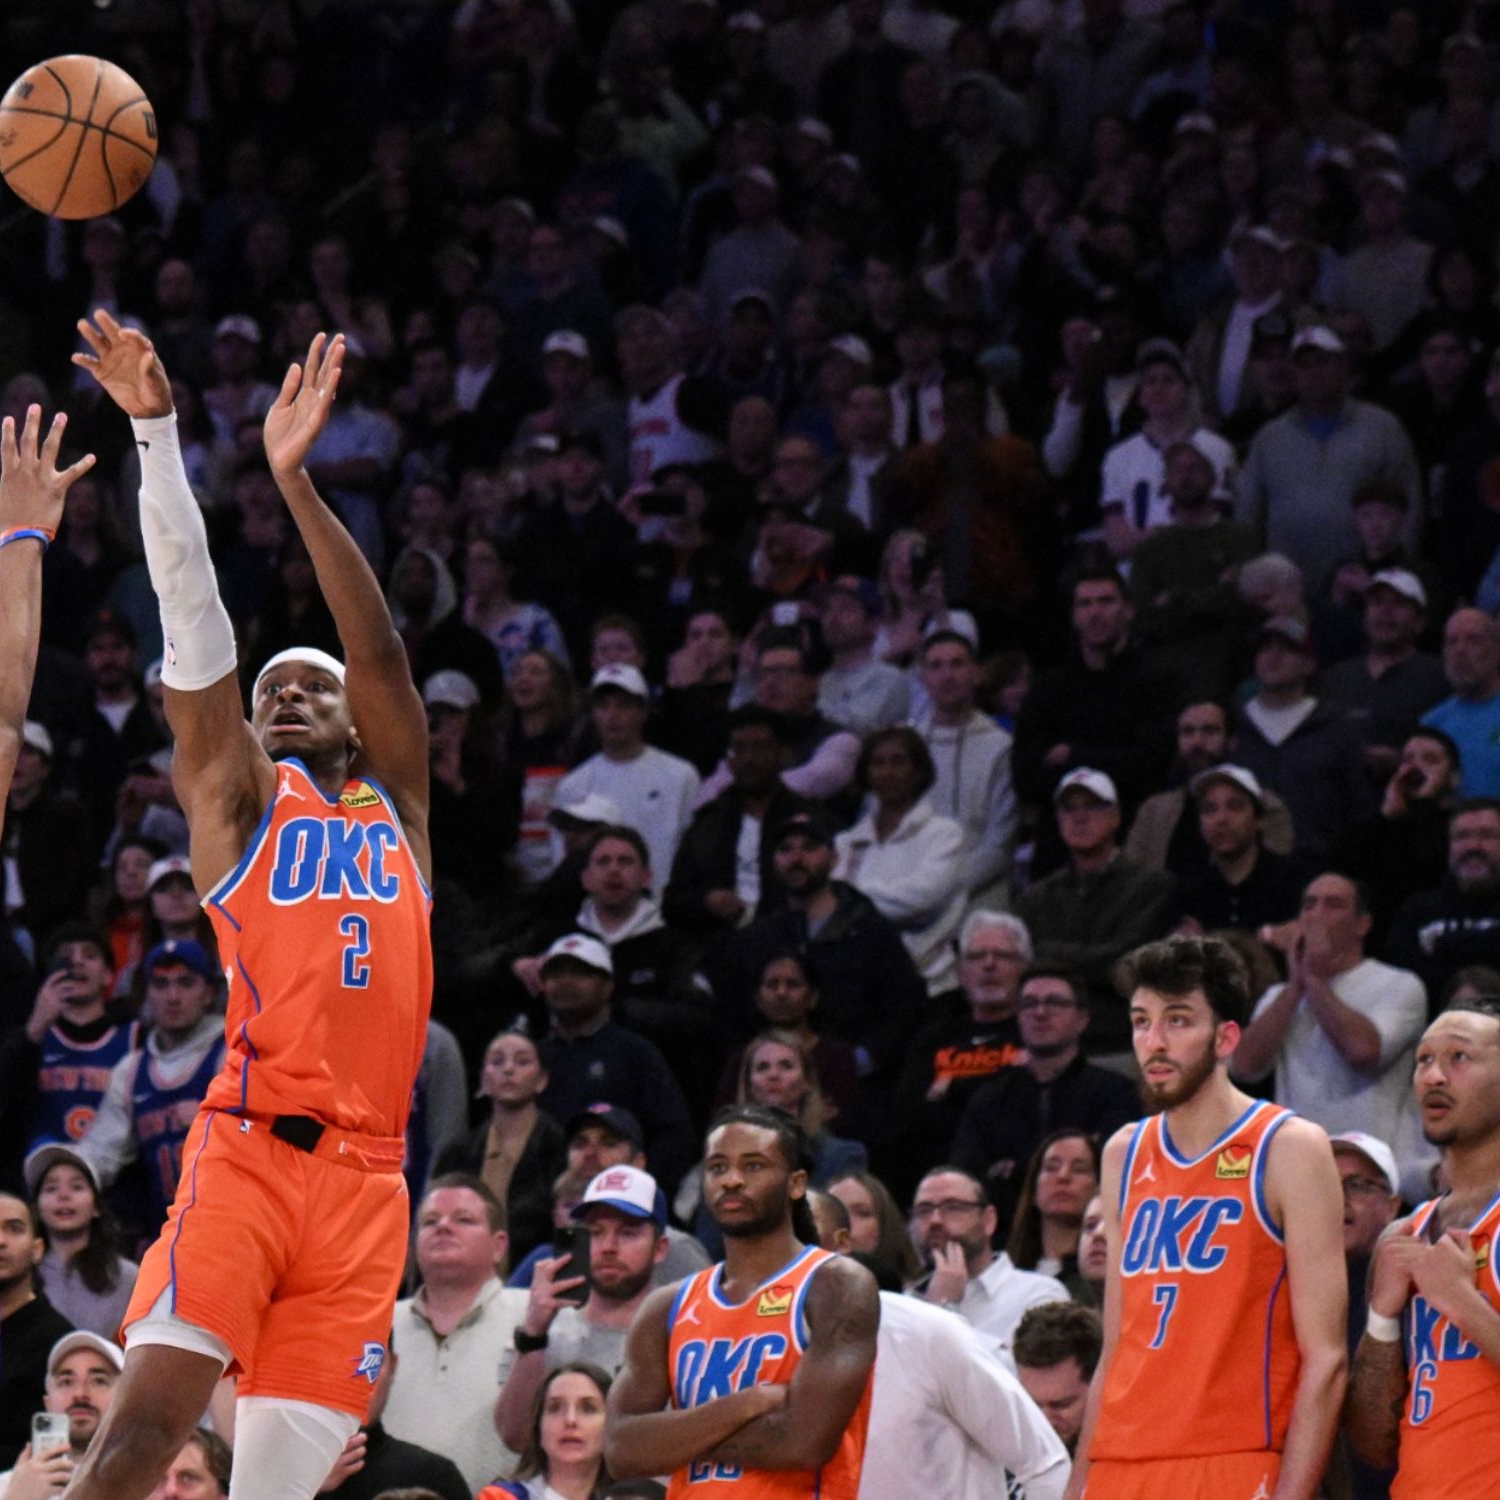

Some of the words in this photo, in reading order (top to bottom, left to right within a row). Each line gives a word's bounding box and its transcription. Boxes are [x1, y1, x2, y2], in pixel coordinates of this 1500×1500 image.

[268, 816, 400, 906] OKC
[338, 913, 371, 989] 2
[933, 1042, 1017, 1074] Knick
[1120, 1195, 1245, 1278] OKC
[1147, 1283, 1180, 1350] 7
[675, 1331, 789, 1411] OKC
[1409, 1361, 1438, 1426] 6
